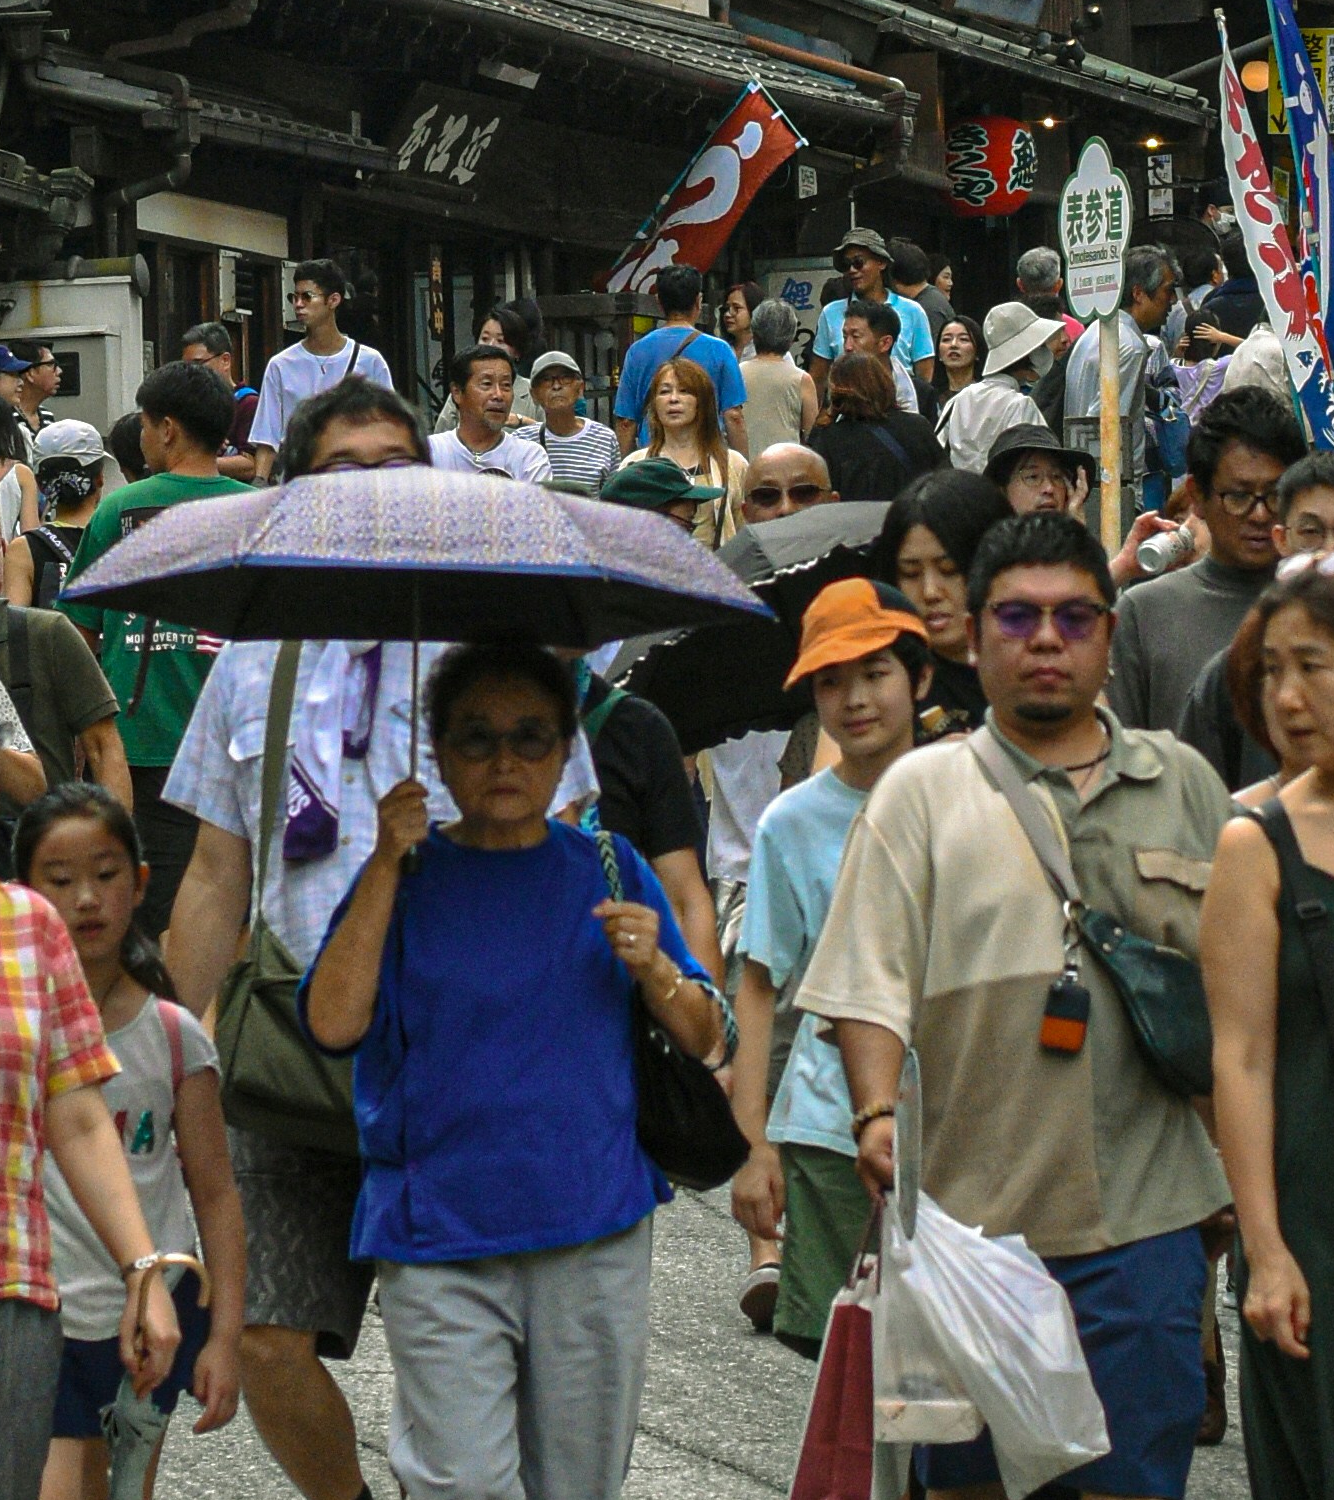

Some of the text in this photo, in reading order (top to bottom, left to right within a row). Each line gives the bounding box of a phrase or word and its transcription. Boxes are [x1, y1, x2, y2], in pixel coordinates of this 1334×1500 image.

[1067, 184, 1123, 247] 表参道
[1069, 247, 1108, 265] Omotesando
